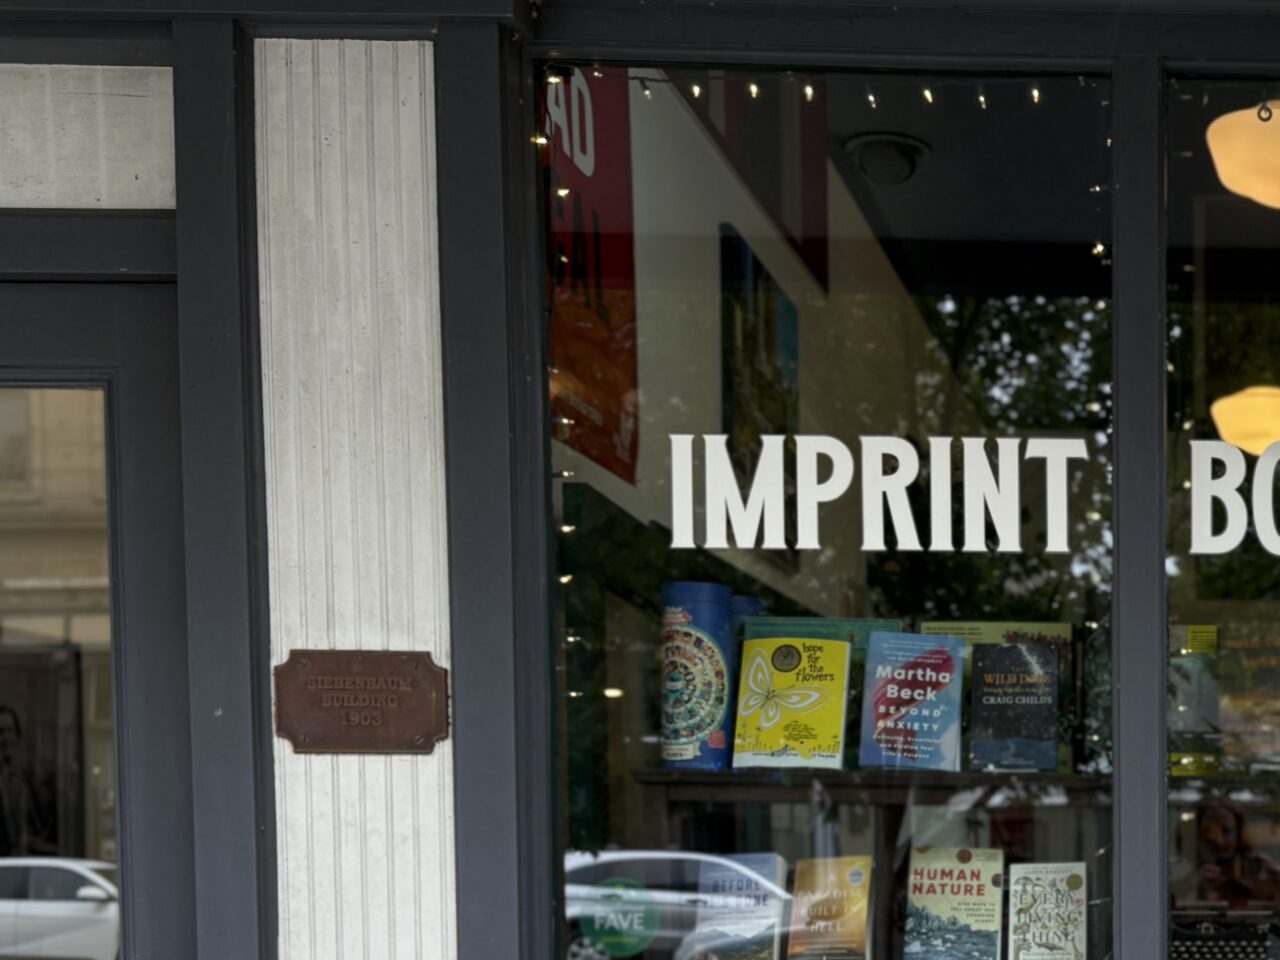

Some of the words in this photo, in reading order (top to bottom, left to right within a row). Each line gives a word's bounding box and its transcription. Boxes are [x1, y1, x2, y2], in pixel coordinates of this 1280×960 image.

[668, 433, 1090, 553] IMPRINT
[802, 643, 824, 656] hope
[807, 654, 820, 664] for
[809, 664, 823, 673] the
[875, 665, 951, 683] Martha
[795, 670, 834, 682] flowers
[983, 673, 1017, 684] WILD
[307, 676, 412, 690] SIEBENBAUM
[886, 684, 937, 701] Beck
[321, 694, 399, 707] BUILDING
[982, 695, 1014, 704] CRAIG
[1015, 695, 1052, 704] CHILDS
[878, 705, 941, 717] BEYOND
[340, 711, 382, 726] 1903
[876, 720, 939, 732] ANXIETY
[913, 868, 981, 881] HUMAN
[712, 878, 761, 893] BEFORE
[912, 882, 985, 896] NATURE
[1019, 893, 1076, 905] EVERY
[800, 905, 836, 916] BUILT
[594, 912, 645, 930] FAVE
[1017, 912, 1079, 924] LIVING
[810, 920, 844, 932] HELL
[1020, 930, 1076, 943] THING
